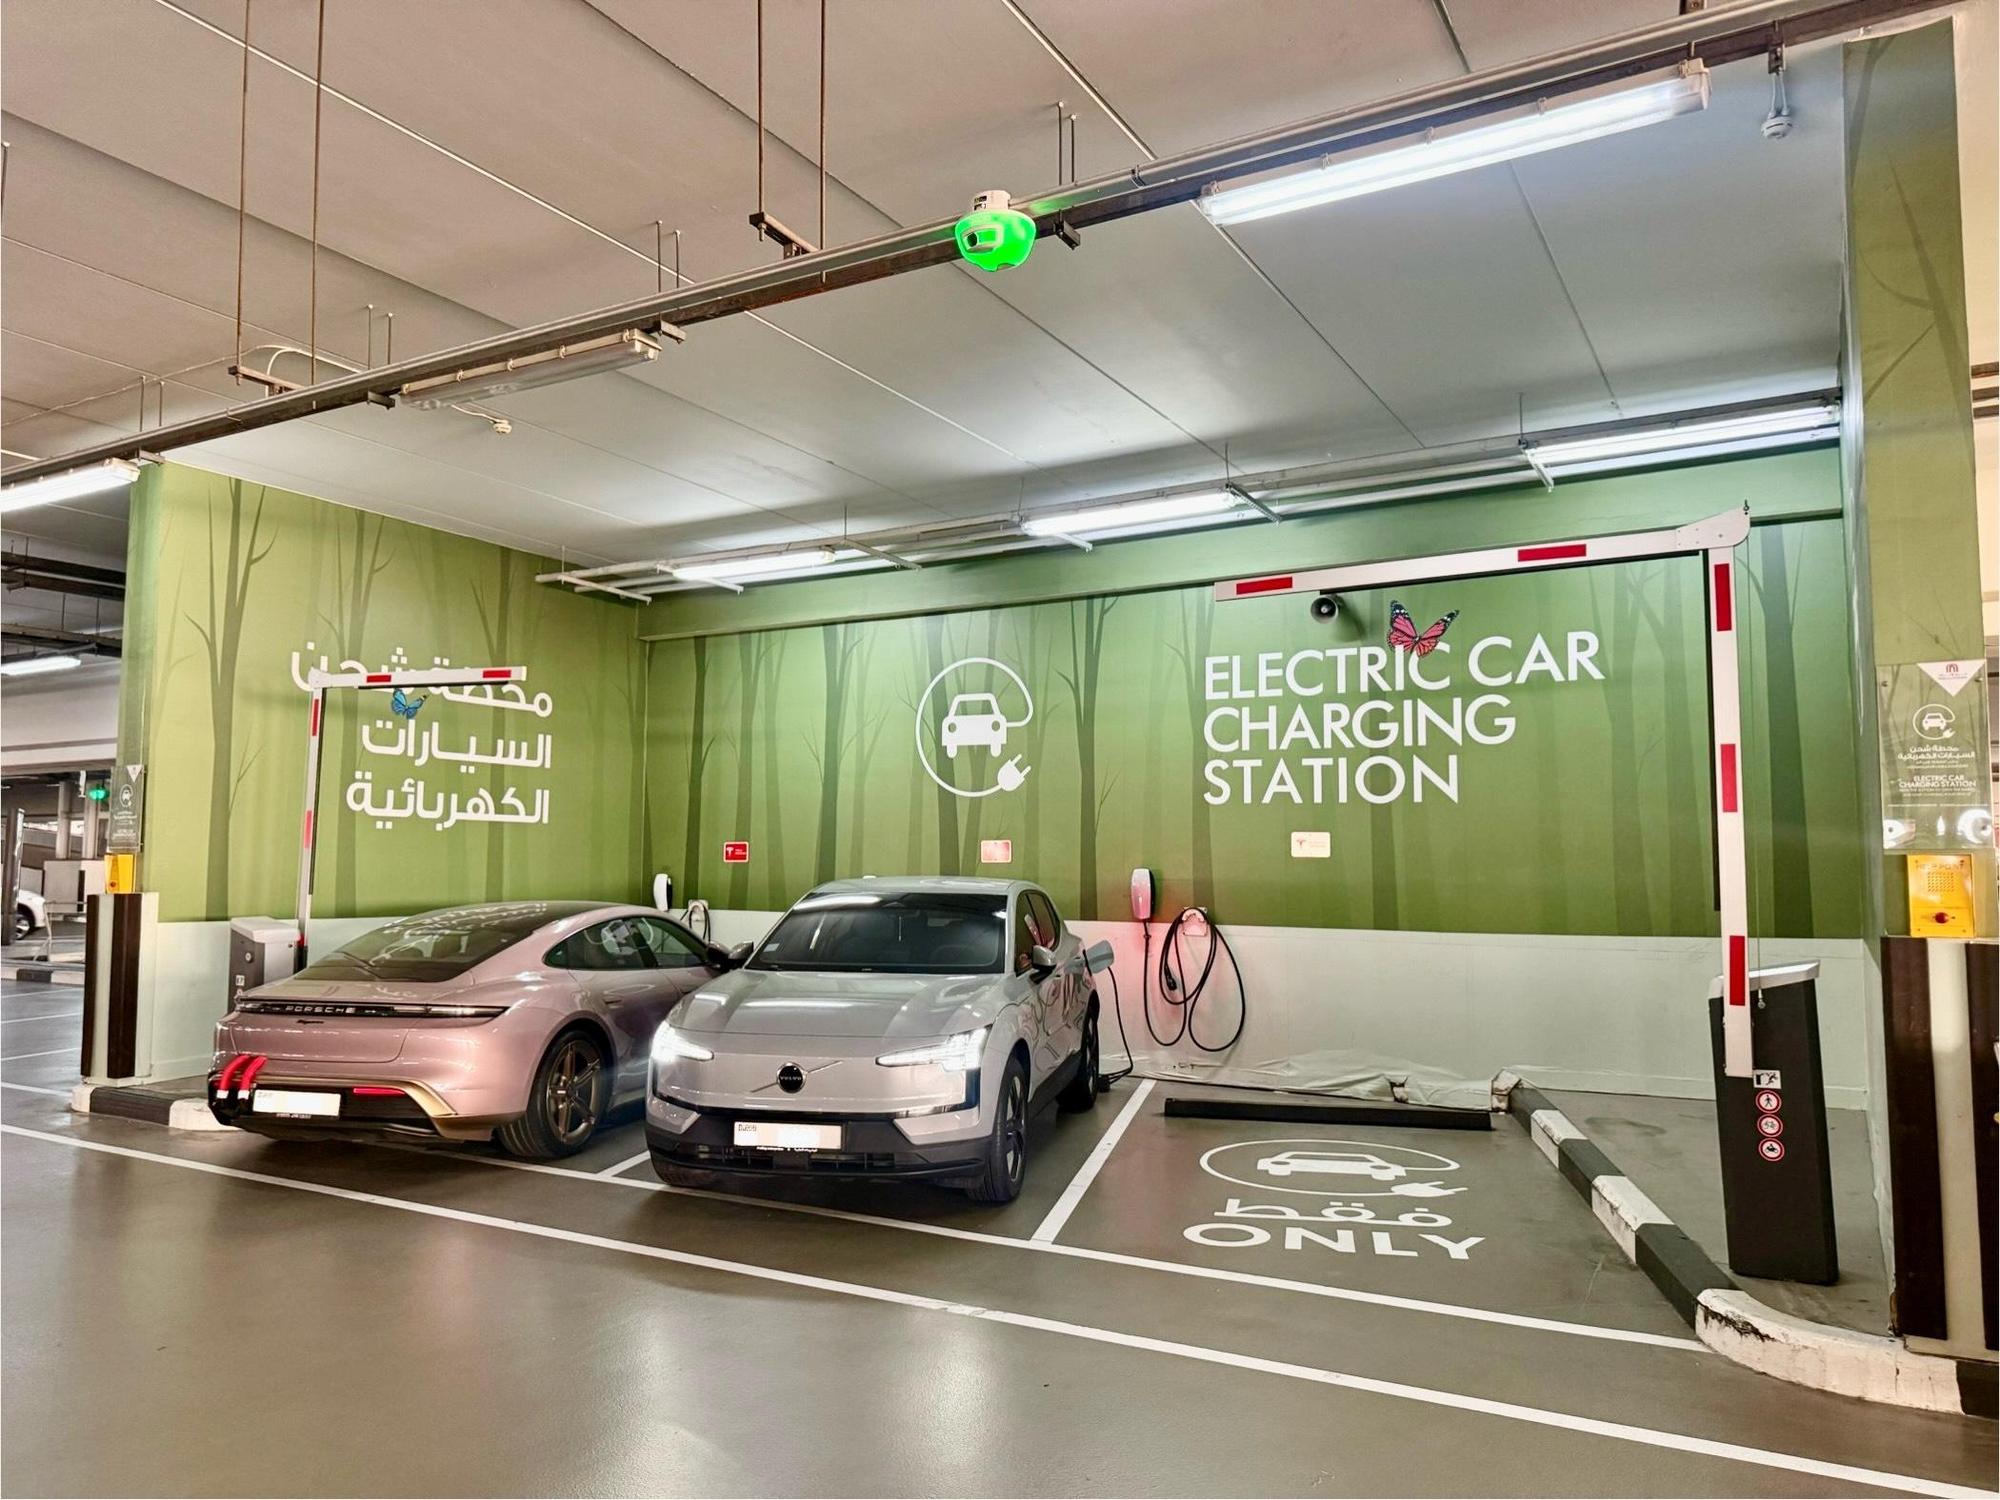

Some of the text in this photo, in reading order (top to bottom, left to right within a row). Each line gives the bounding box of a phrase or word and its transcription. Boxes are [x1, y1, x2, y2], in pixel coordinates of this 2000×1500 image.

[1204, 631, 1606, 700] ELECTRIC CAR
[361, 718, 552, 774] السيارات
[1203, 694, 1517, 753] CHARGING
[1203, 754, 1459, 806] STATION
[1913, 774, 1947, 782] ELECTRIC
[1941, 780, 1977, 788] STATION
[345, 770, 550, 832] الكهربائية
[285, 1005, 356, 1014] PORSCHE
[1213, 1198, 1453, 1228] فقط
[1182, 1222, 1486, 1260] ONLY
